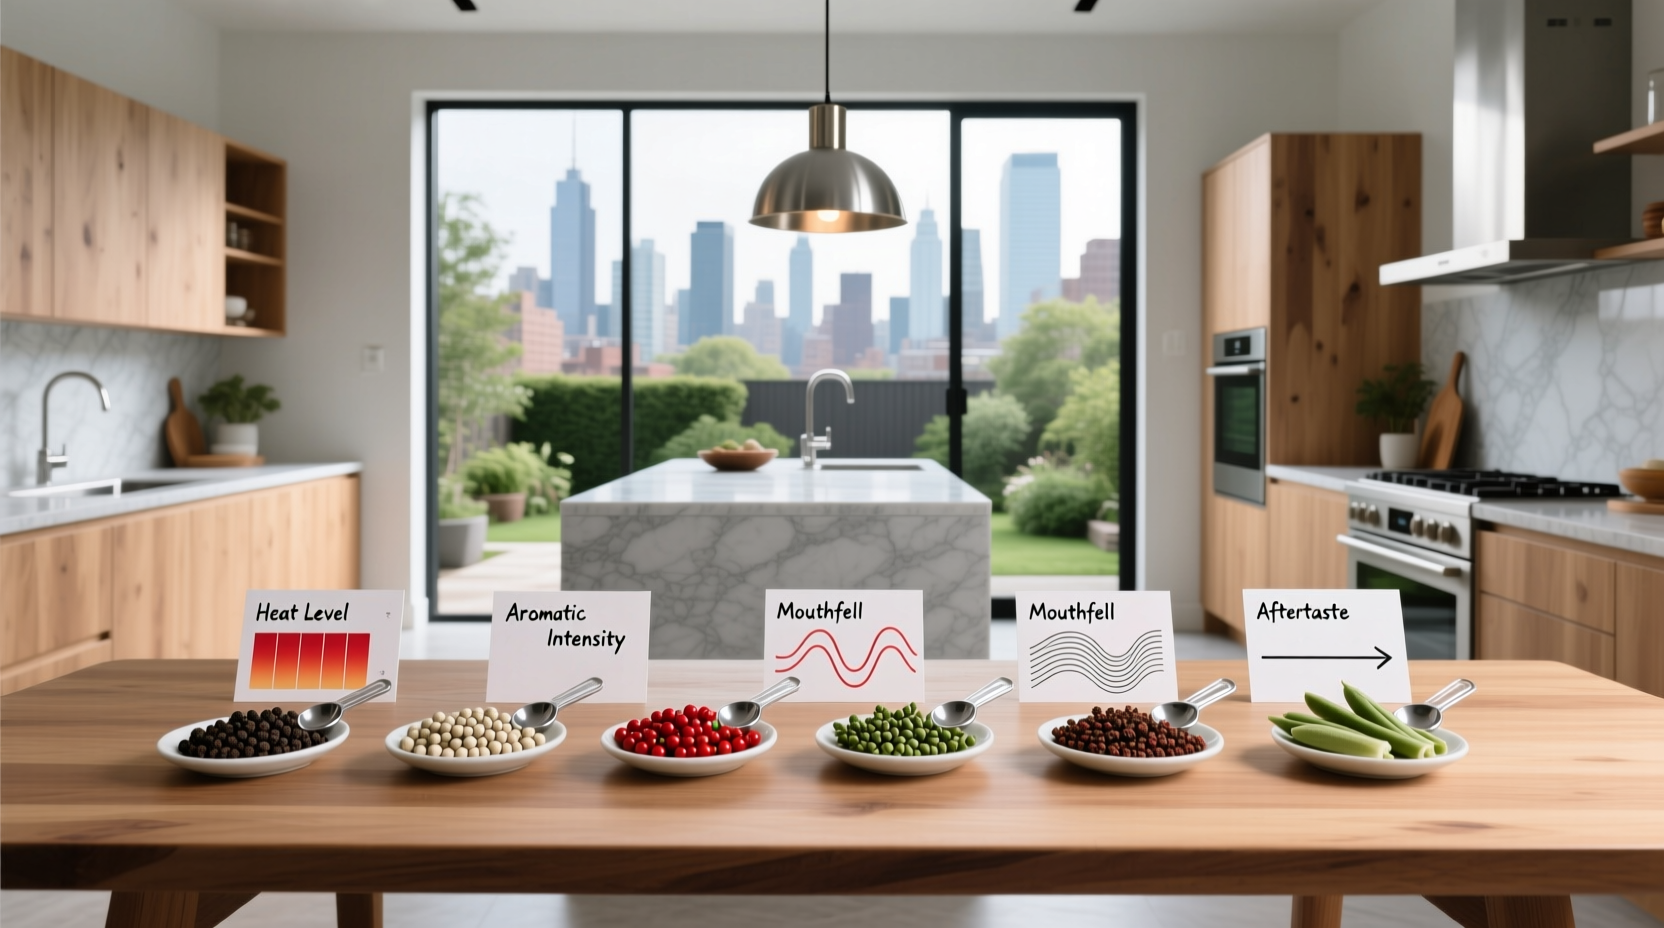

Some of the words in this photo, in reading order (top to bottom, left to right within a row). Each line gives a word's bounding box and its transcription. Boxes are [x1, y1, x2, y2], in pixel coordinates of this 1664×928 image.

[255, 602, 299, 622] Heat
[303, 601, 350, 622] Level
[505, 602, 587, 623] Aromatic
[776, 600, 863, 624] Mouthfell
[1029, 601, 1114, 624] Mouthfell
[1256, 600, 1350, 624] Aftertaste
[547, 628, 627, 655] Intensity
